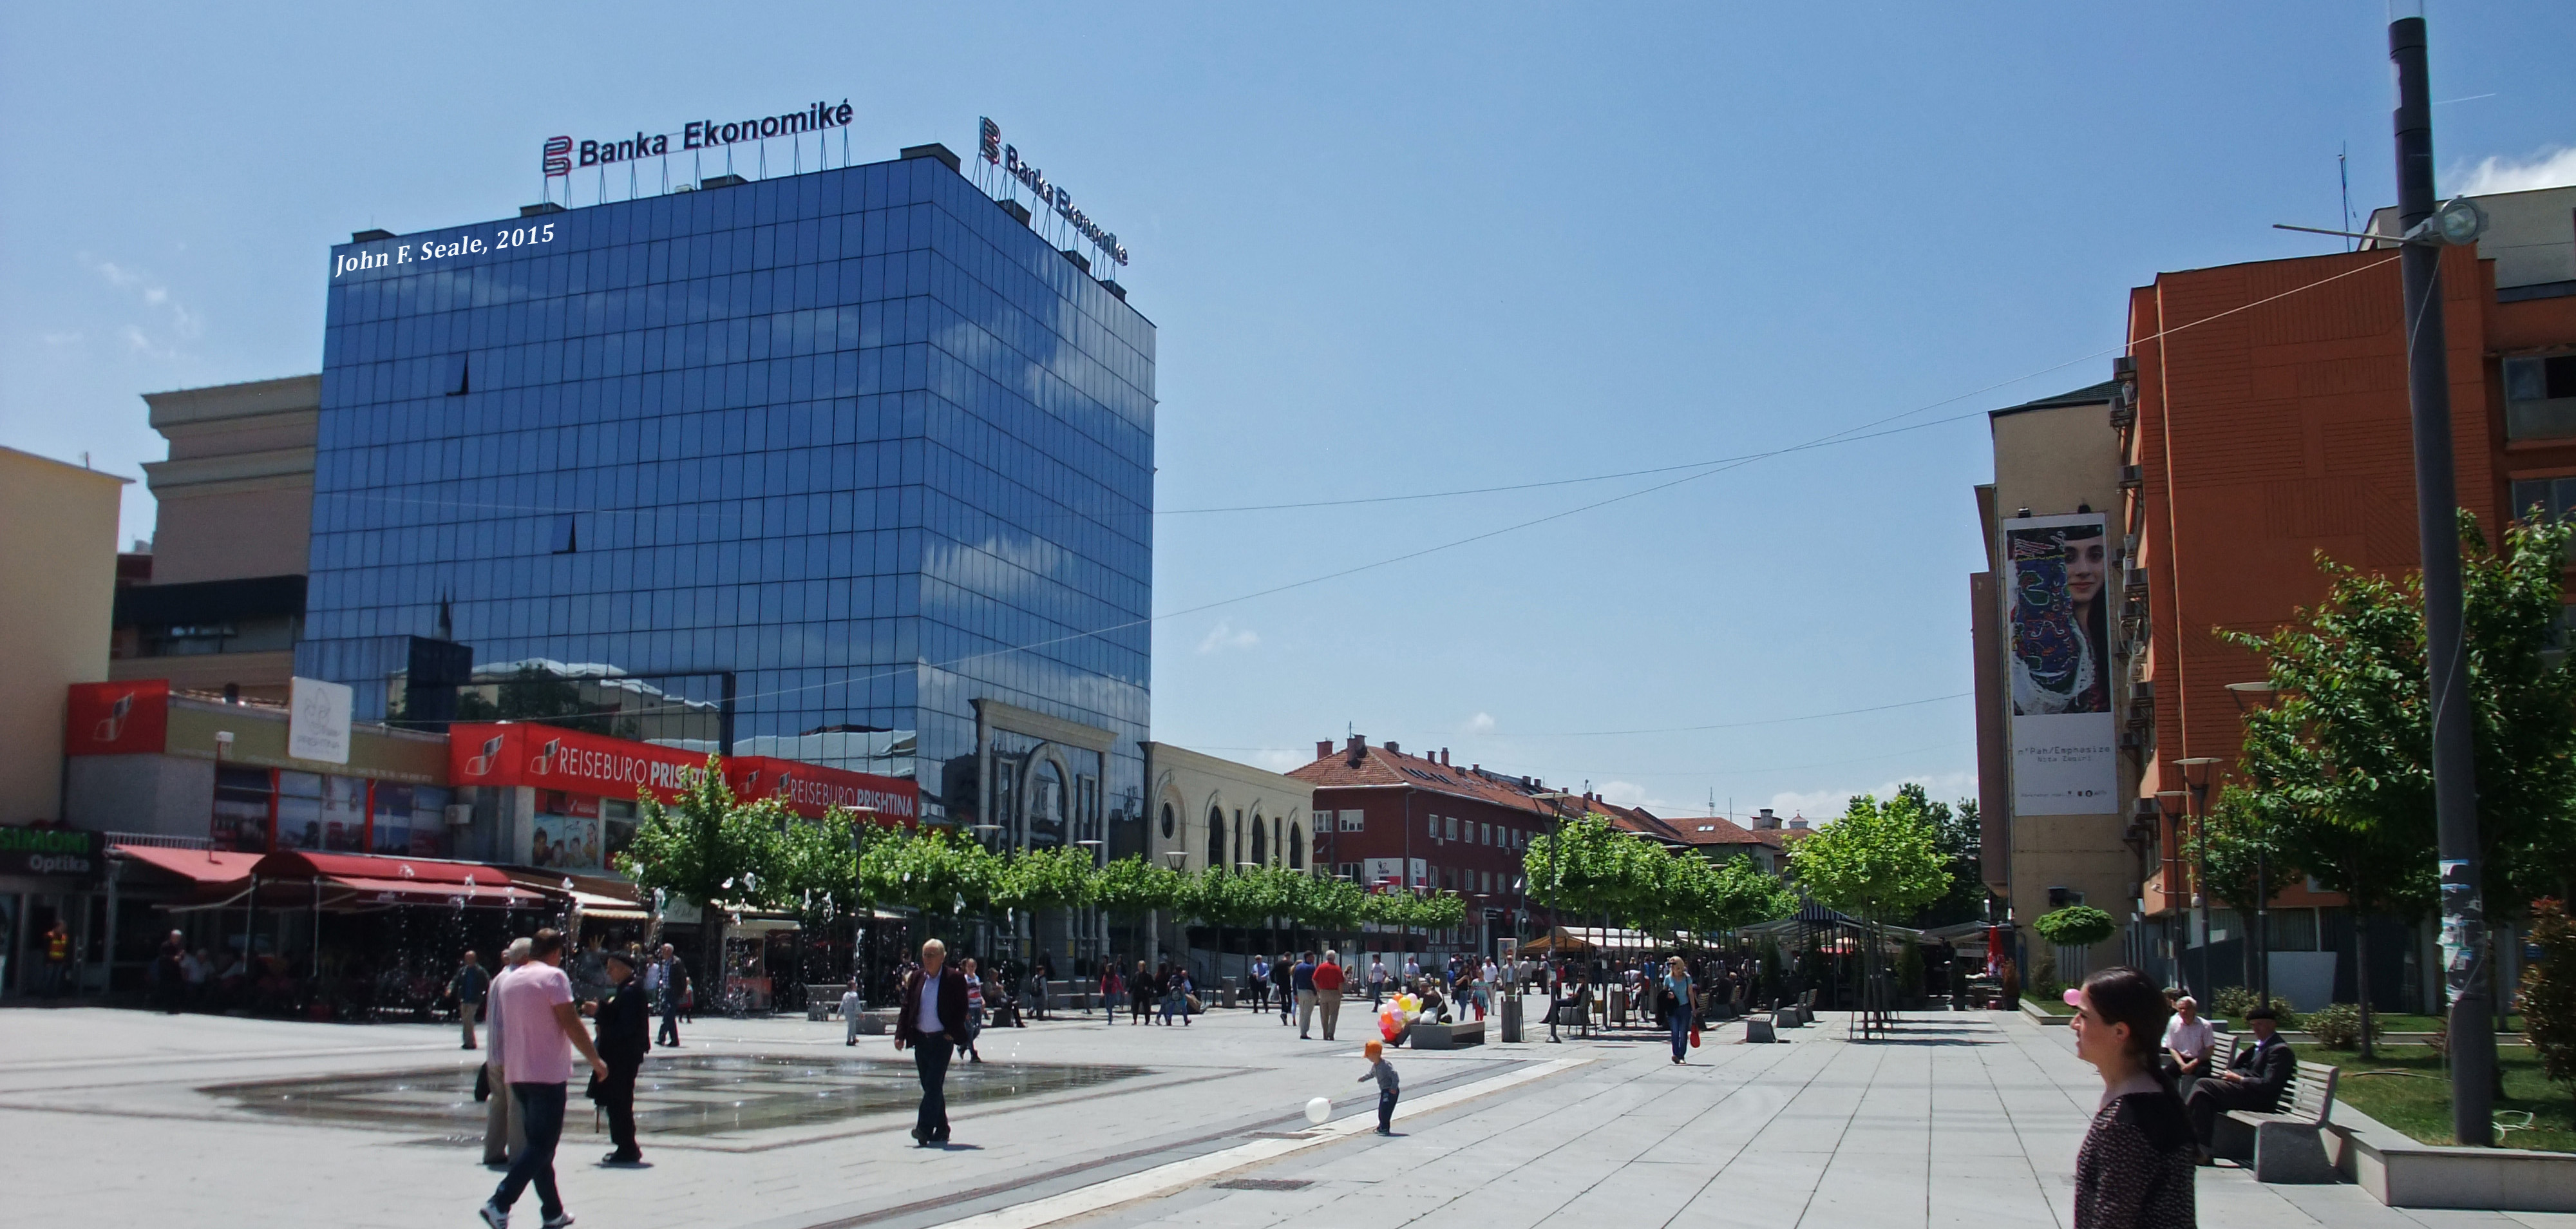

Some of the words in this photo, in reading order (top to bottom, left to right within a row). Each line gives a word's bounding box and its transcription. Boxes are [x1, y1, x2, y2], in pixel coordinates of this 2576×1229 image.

[580, 131, 668, 167] Banka
[1005, 143, 1054, 206] Banka
[857, 788, 914, 817] PRISHTINA
[0, 827, 89, 854] SIMONI
[30, 854, 90, 874] Optika
